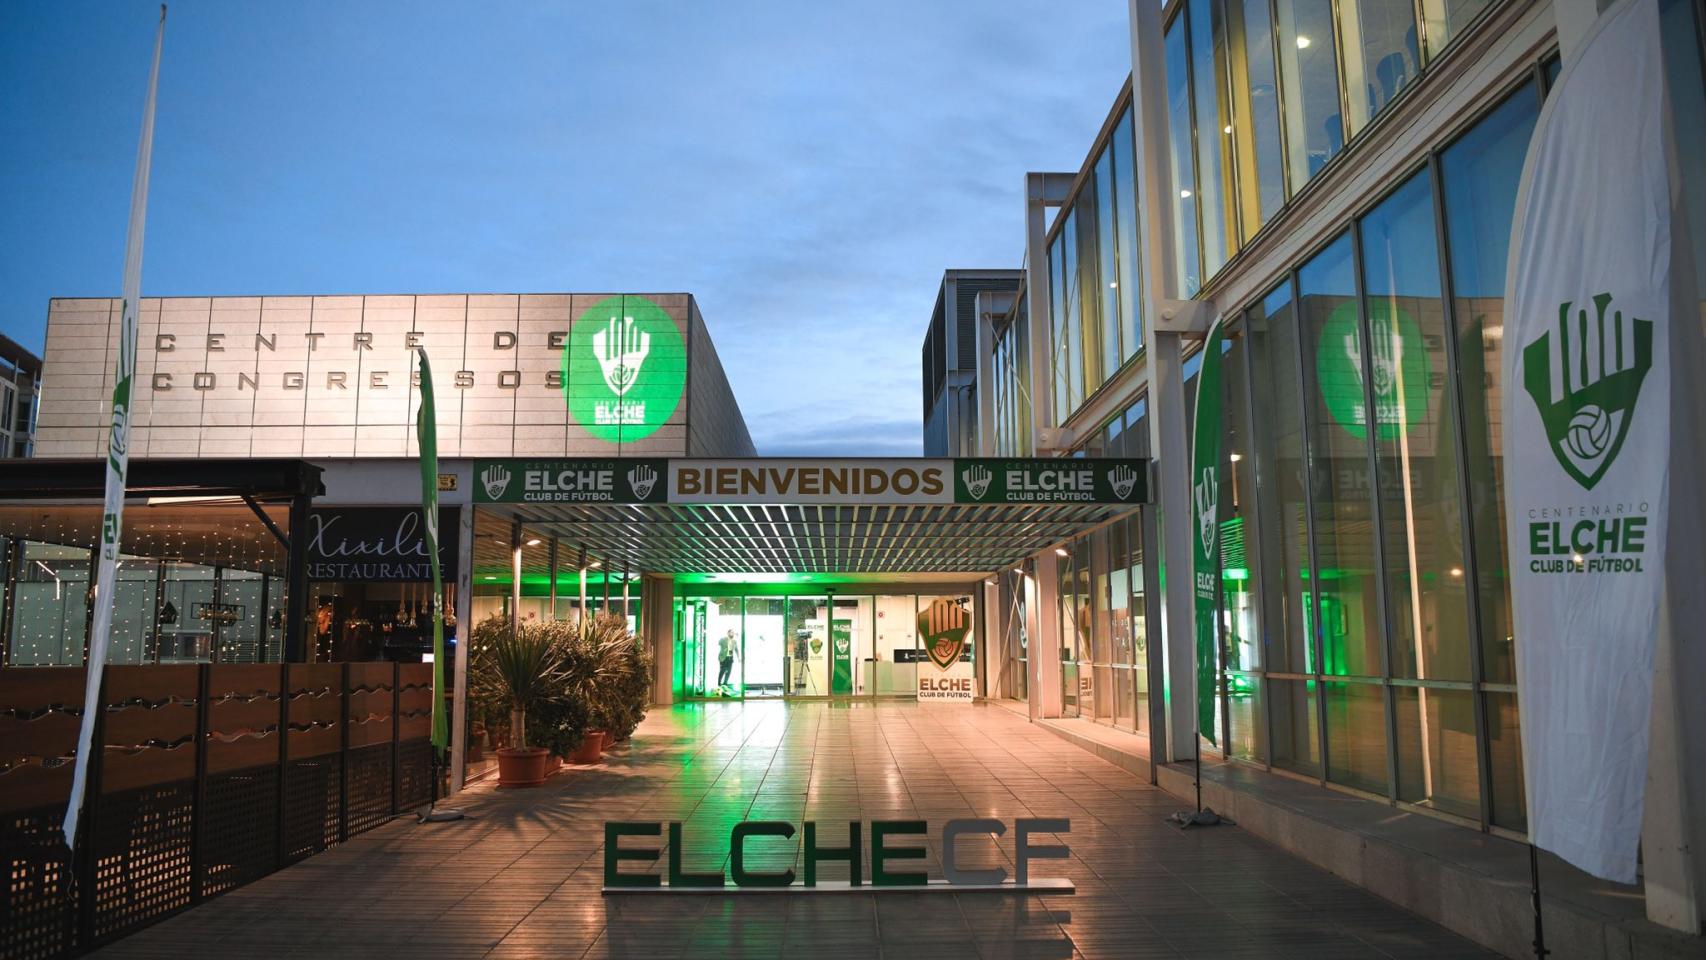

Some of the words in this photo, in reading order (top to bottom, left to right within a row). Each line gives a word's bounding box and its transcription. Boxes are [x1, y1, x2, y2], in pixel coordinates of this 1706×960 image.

[155, 332, 425, 352] CENTRE
[493, 331, 568, 350] DE
[594, 405, 645, 419] ELCHE
[524, 470, 614, 491] ELCHE
[677, 467, 944, 496] BIENVENIDOS
[1006, 470, 1095, 491] ELCHE
[523, 492, 553, 501] CLUB
[555, 492, 569, 501] DE
[573, 490, 614, 501] FÚTBOL
[1006, 492, 1034, 501] CLUB
[1036, 492, 1050, 501] DE
[1053, 490, 1096, 501] FÚTBOL
[1528, 502, 1649, 519] CENTENARIO
[1529, 516, 1648, 555] ELCHE
[1530, 560, 1564, 573] CLUB
[1566, 559, 1585, 573] DE
[1588, 556, 1643, 573] FÚTBOL
[919, 678, 971, 691] ELCHE
